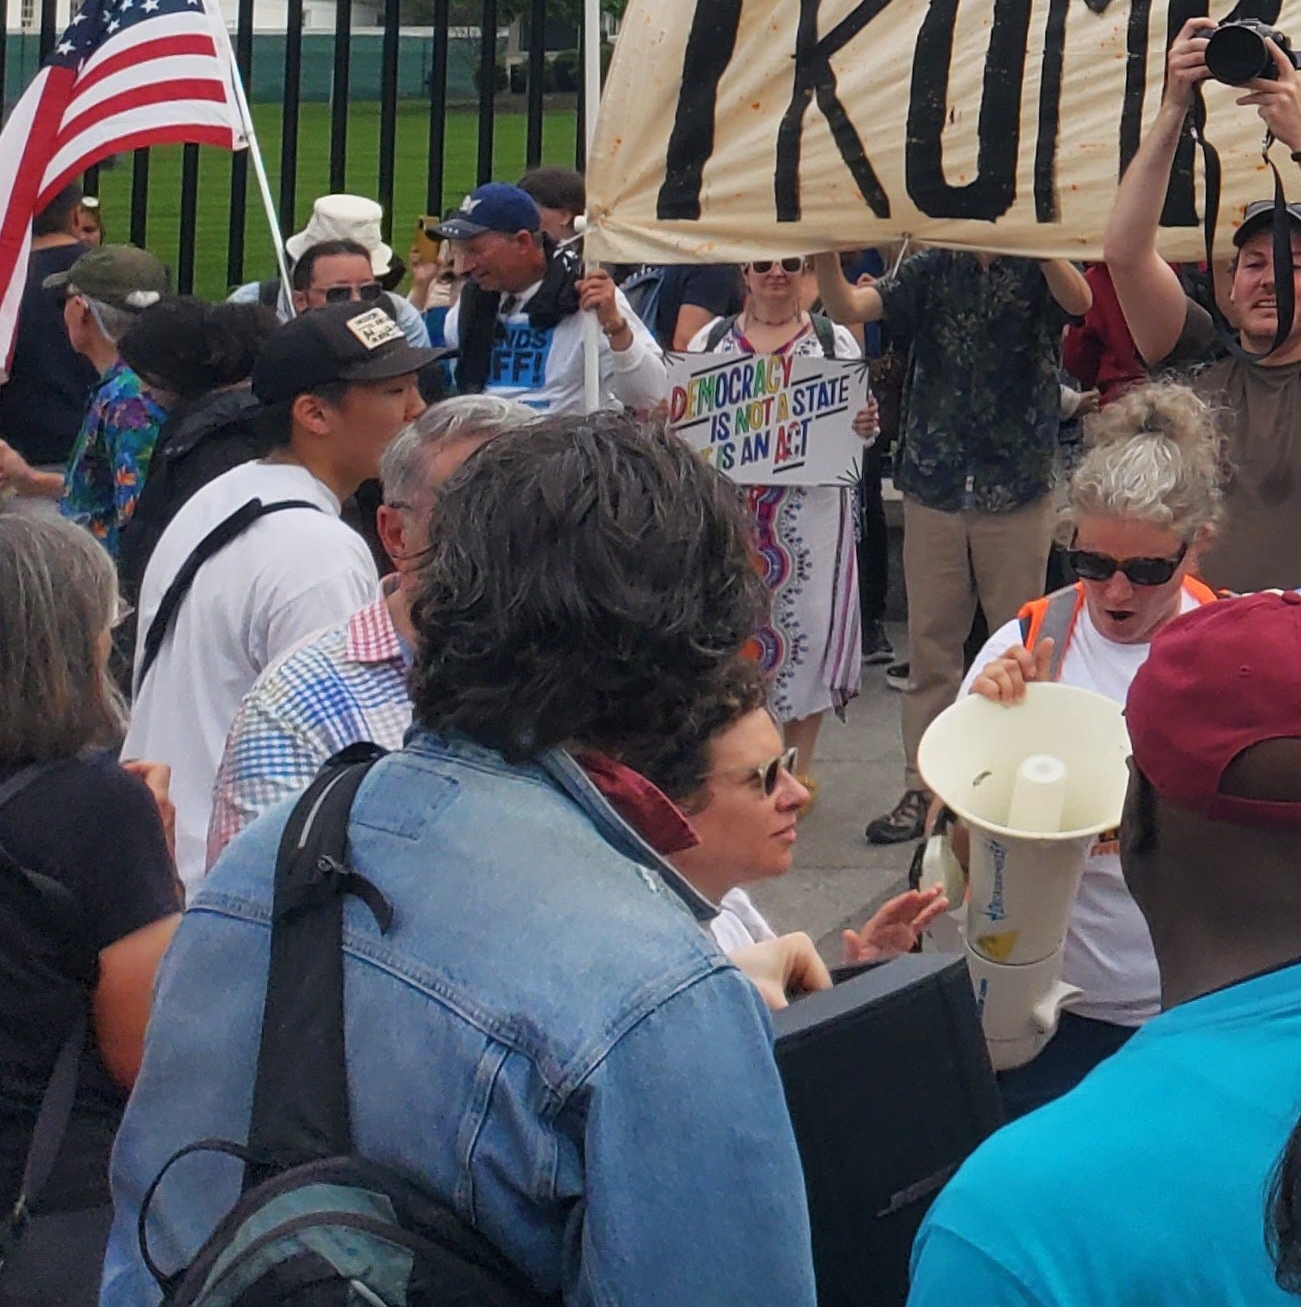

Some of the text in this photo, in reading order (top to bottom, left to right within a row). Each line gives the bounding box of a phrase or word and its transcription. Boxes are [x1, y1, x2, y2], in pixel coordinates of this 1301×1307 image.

[492, 351, 542, 383] FF!
[670, 354, 794, 424] DEMOCRACY
[711, 375, 850, 443] IS NOT A STATE
[716, 442, 735, 470] IS
[741, 430, 770, 465] AN
[774, 418, 812, 464] ACT
